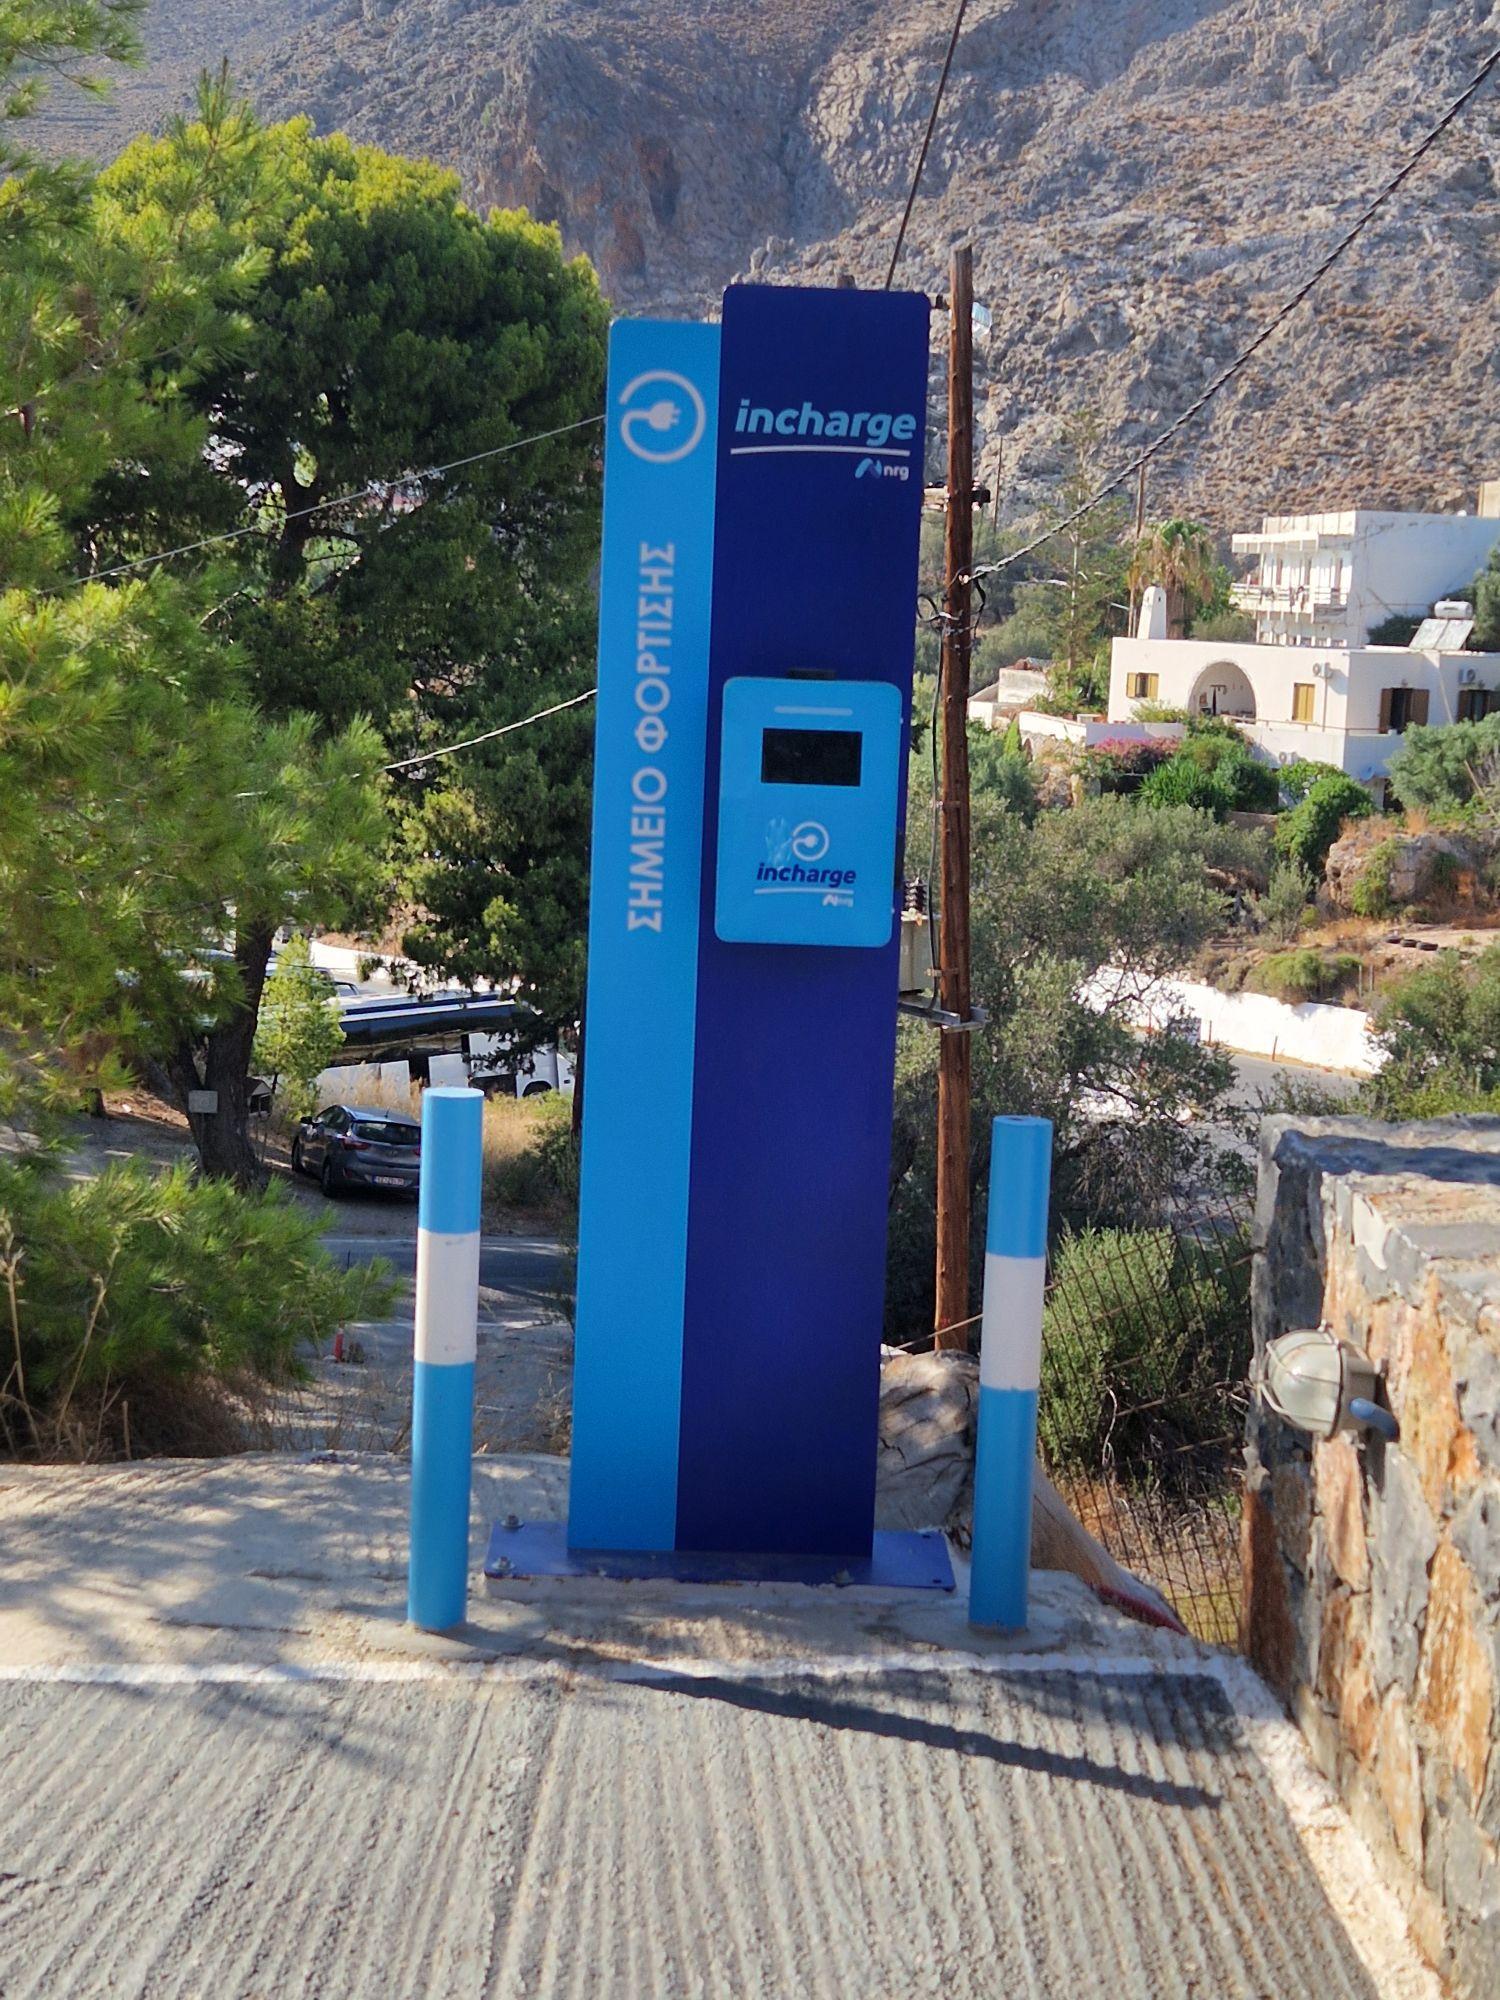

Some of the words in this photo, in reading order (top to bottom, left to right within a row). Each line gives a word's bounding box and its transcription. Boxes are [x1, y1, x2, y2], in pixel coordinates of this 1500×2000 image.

[735, 399, 917, 447] incharge
[884, 465, 909, 481] nrg
[634, 541, 676, 754] ΦΟΡΤΙΣΗΣ
[627, 767, 668, 933] ΣΗΜΕΙΟ
[756, 862, 857, 888] incharge
